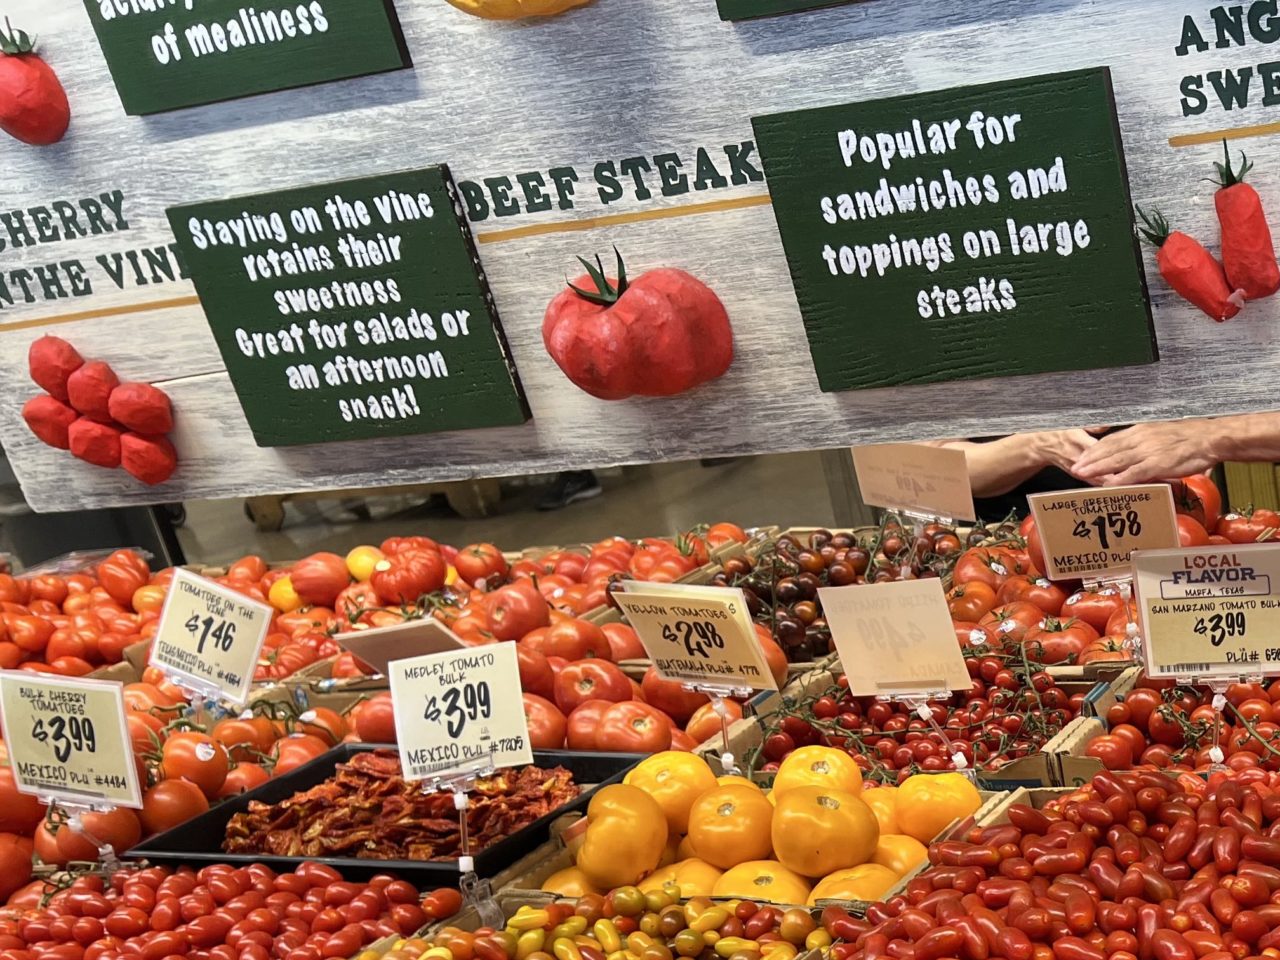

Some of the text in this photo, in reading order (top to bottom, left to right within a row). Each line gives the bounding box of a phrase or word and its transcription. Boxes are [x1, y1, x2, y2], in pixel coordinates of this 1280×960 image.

[151, 23, 182, 65] of
[184, 1, 329, 58] mealiness
[838, 109, 1022, 168] Popular for
[458, 141, 764, 222] BEEF STEAK
[820, 156, 1068, 224] sandwiches and
[0, 190, 129, 250] HERRY
[189, 190, 434, 250] Staying on the vine
[243, 233, 401, 282] retains their
[822, 216, 1091, 279] toppings on large
[274, 278, 401, 315] sweetness
[918, 276, 1018, 320] steaks
[236, 308, 470, 358] Great for salads or
[286, 351, 448, 390] an afternoon
[339, 384, 420, 422] snack!
[1043, 500, 1077, 511] LARGE
[1083, 493, 1151, 508] GREENHOUSE
[1072, 503, 1132, 516] TOMATOES
[1053, 551, 1107, 567] MEXICO
[1184, 553, 1242, 570] LOCAL
[1172, 567, 1256, 584] FLAVOR
[179, 581, 255, 620] TOMATOES ON THE
[1152, 605, 1169, 614] SAN
[1173, 603, 1216, 613] MARZANO
[1219, 601, 1256, 611] TOMATO
[1185, 586, 1245, 598] MARFA, TEXAS
[206, 603, 225, 618] VINE
[624, 603, 667, 616] YELLOW
[670, 607, 728, 620] TOMATOES
[1193, 611, 1246, 647] $399
[199, 660, 213, 675] PLU
[404, 653, 494, 680] MEDLEY TOMATO
[439, 672, 466, 686] BULK
[656, 659, 707, 674] GUATEMALA
[20, 687, 86, 705] BULK CHERRY
[31, 700, 85, 715] TOMATOES
[424, 681, 491, 739] $399
[31, 714, 96, 763] $399
[408, 743, 459, 766] MEXICO
[463, 744, 483, 758] PLU
[17, 762, 67, 781] MEXICO
[70, 771, 90, 785] PLU
